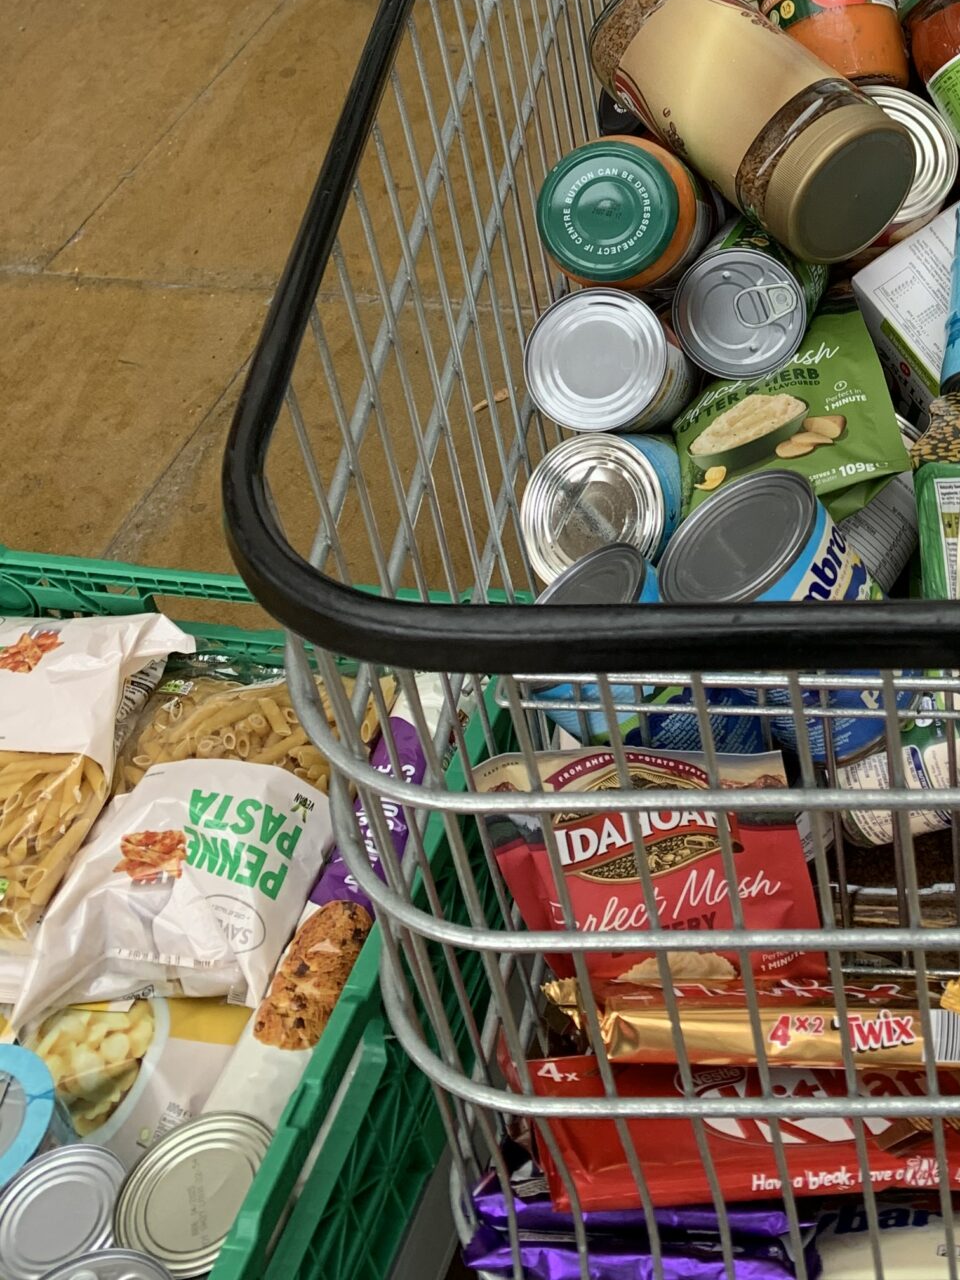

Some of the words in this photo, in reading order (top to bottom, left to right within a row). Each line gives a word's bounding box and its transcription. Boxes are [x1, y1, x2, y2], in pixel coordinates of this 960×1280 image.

[565, 172, 594, 204] BUTTON
[597, 168, 618, 176] CAN
[621, 170, 634, 182] BE
[634, 181, 651, 237] DEPRESSED
[563, 208, 582, 244] CENTRE
[584, 244, 594, 252] IF
[597, 238, 635, 255] REJECT
[768, 379, 821, 393] FLAVOURED
[825, 390, 852, 404] Perfect
[679, 392, 745, 433] UTTER
[765, 368, 820, 387] HERB
[831, 394, 867, 410] MINUTE
[838, 462, 876, 477] 109g
[558, 763, 583, 783] FROM
[638, 754, 674, 768] POTATO
[677, 763, 707, 779] STATE
[188, 789, 303, 860] PASTA
[183, 825, 288, 901] PENNE
[673, 868, 781, 919] Mash
[752, 1174, 785, 1191] Hav
[794, 1177, 803, 1188] a
[805, 1166, 854, 1190] break,
